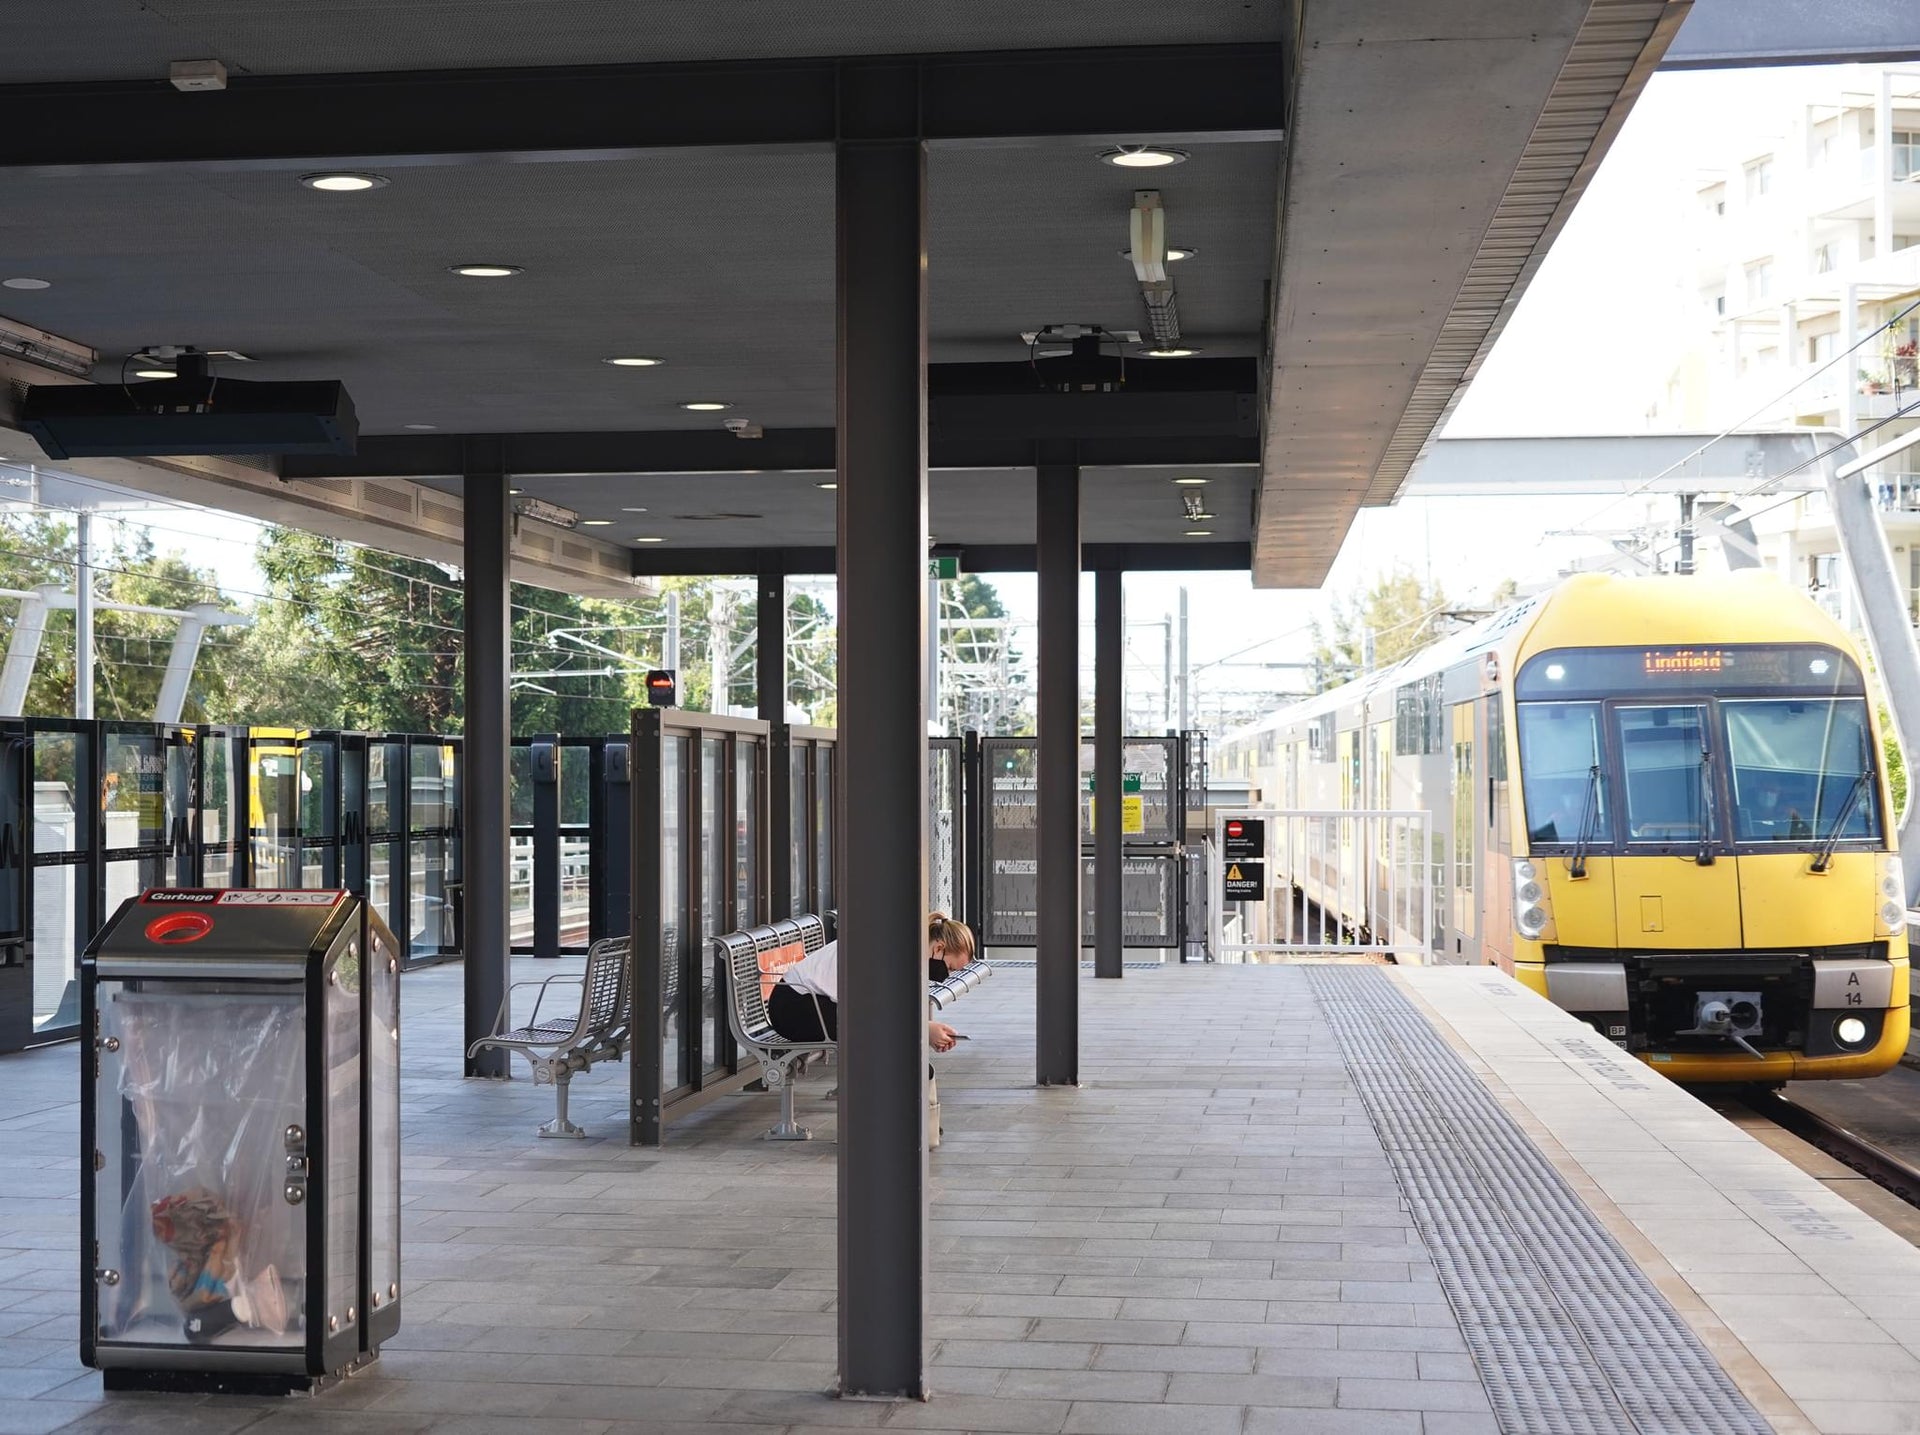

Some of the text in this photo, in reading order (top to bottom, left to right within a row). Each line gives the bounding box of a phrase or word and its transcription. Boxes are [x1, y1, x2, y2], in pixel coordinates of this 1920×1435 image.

[1645, 651, 1721, 672] Lindfield
[150, 892, 214, 902] Garbage
[1847, 972, 1860, 986] A
[1845, 992, 1862, 1005] 14
[1611, 1026, 1625, 1035] BP
